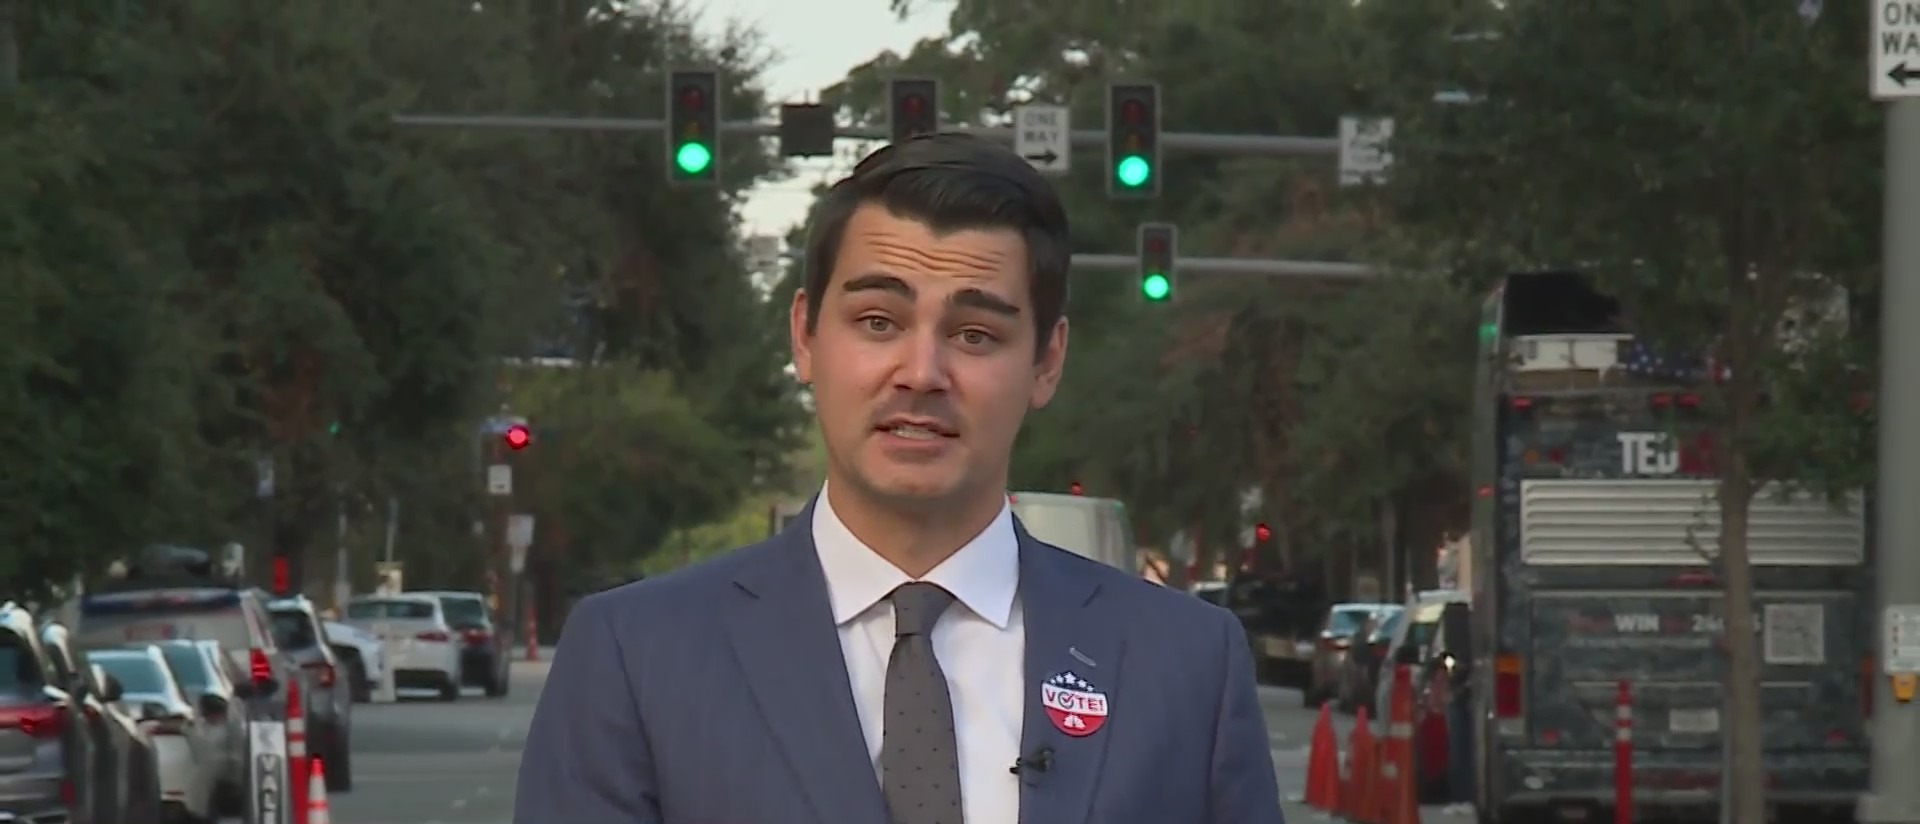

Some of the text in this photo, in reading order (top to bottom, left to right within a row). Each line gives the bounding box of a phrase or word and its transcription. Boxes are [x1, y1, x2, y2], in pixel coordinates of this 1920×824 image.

[1024, 110, 1058, 127] ONE
[1023, 130, 1059, 144] WAY
[1615, 613, 1660, 632] WIN
[1045, 688, 1104, 712] VOTE!
